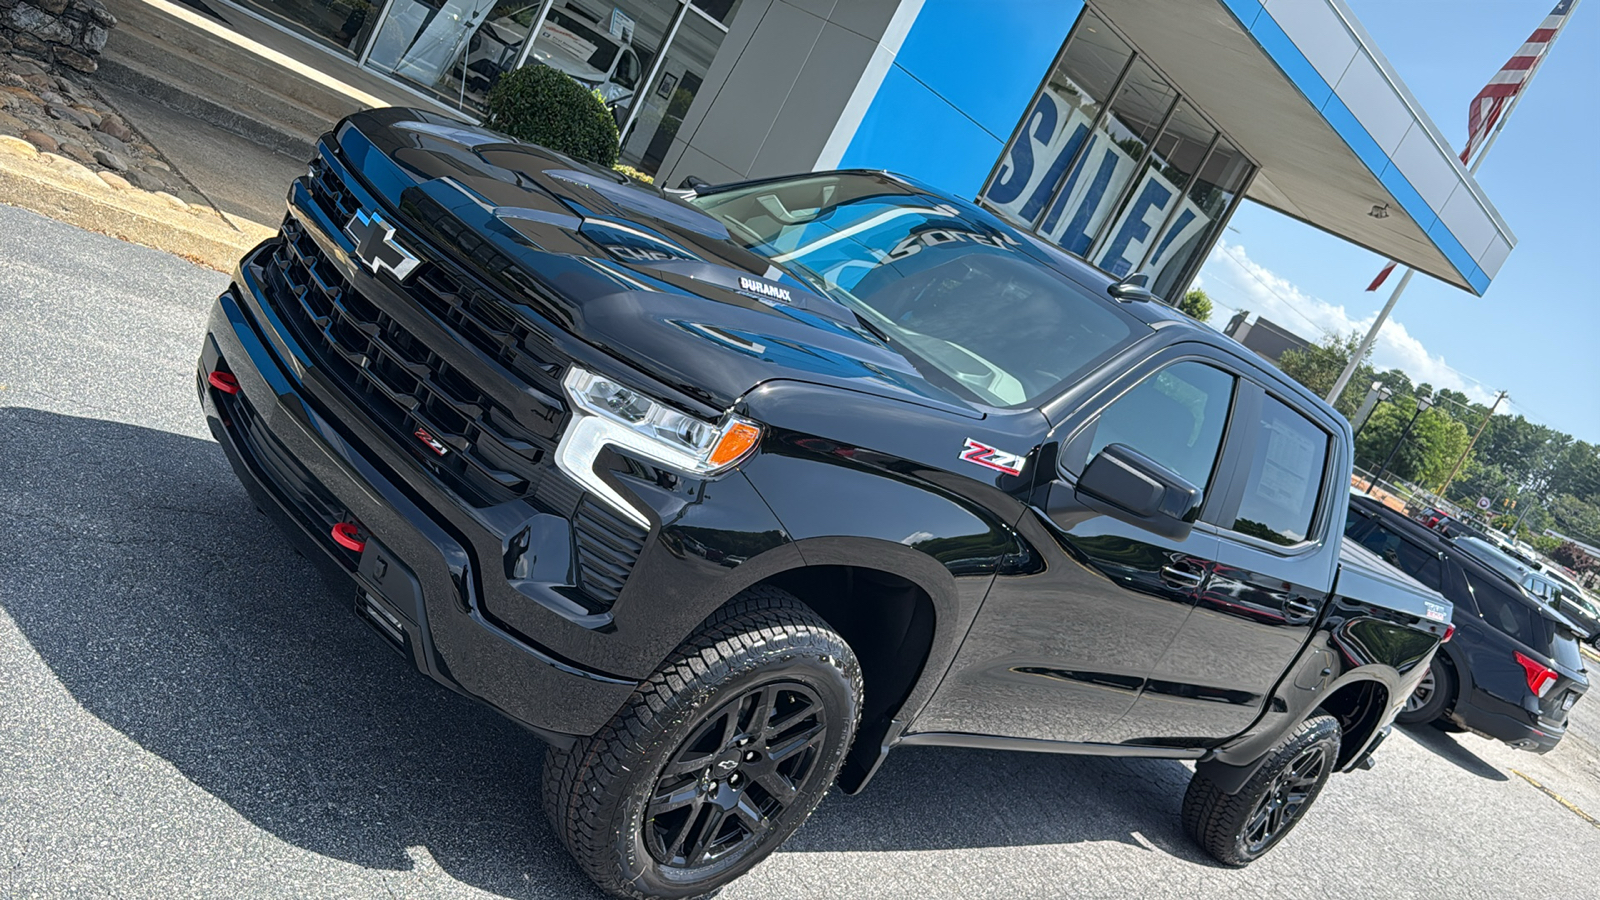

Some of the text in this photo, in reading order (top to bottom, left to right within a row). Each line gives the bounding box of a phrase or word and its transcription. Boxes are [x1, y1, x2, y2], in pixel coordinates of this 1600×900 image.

[740, 276, 792, 302] DURAMAX
[414, 427, 448, 457] Z71
[957, 437, 1027, 477] Z71
